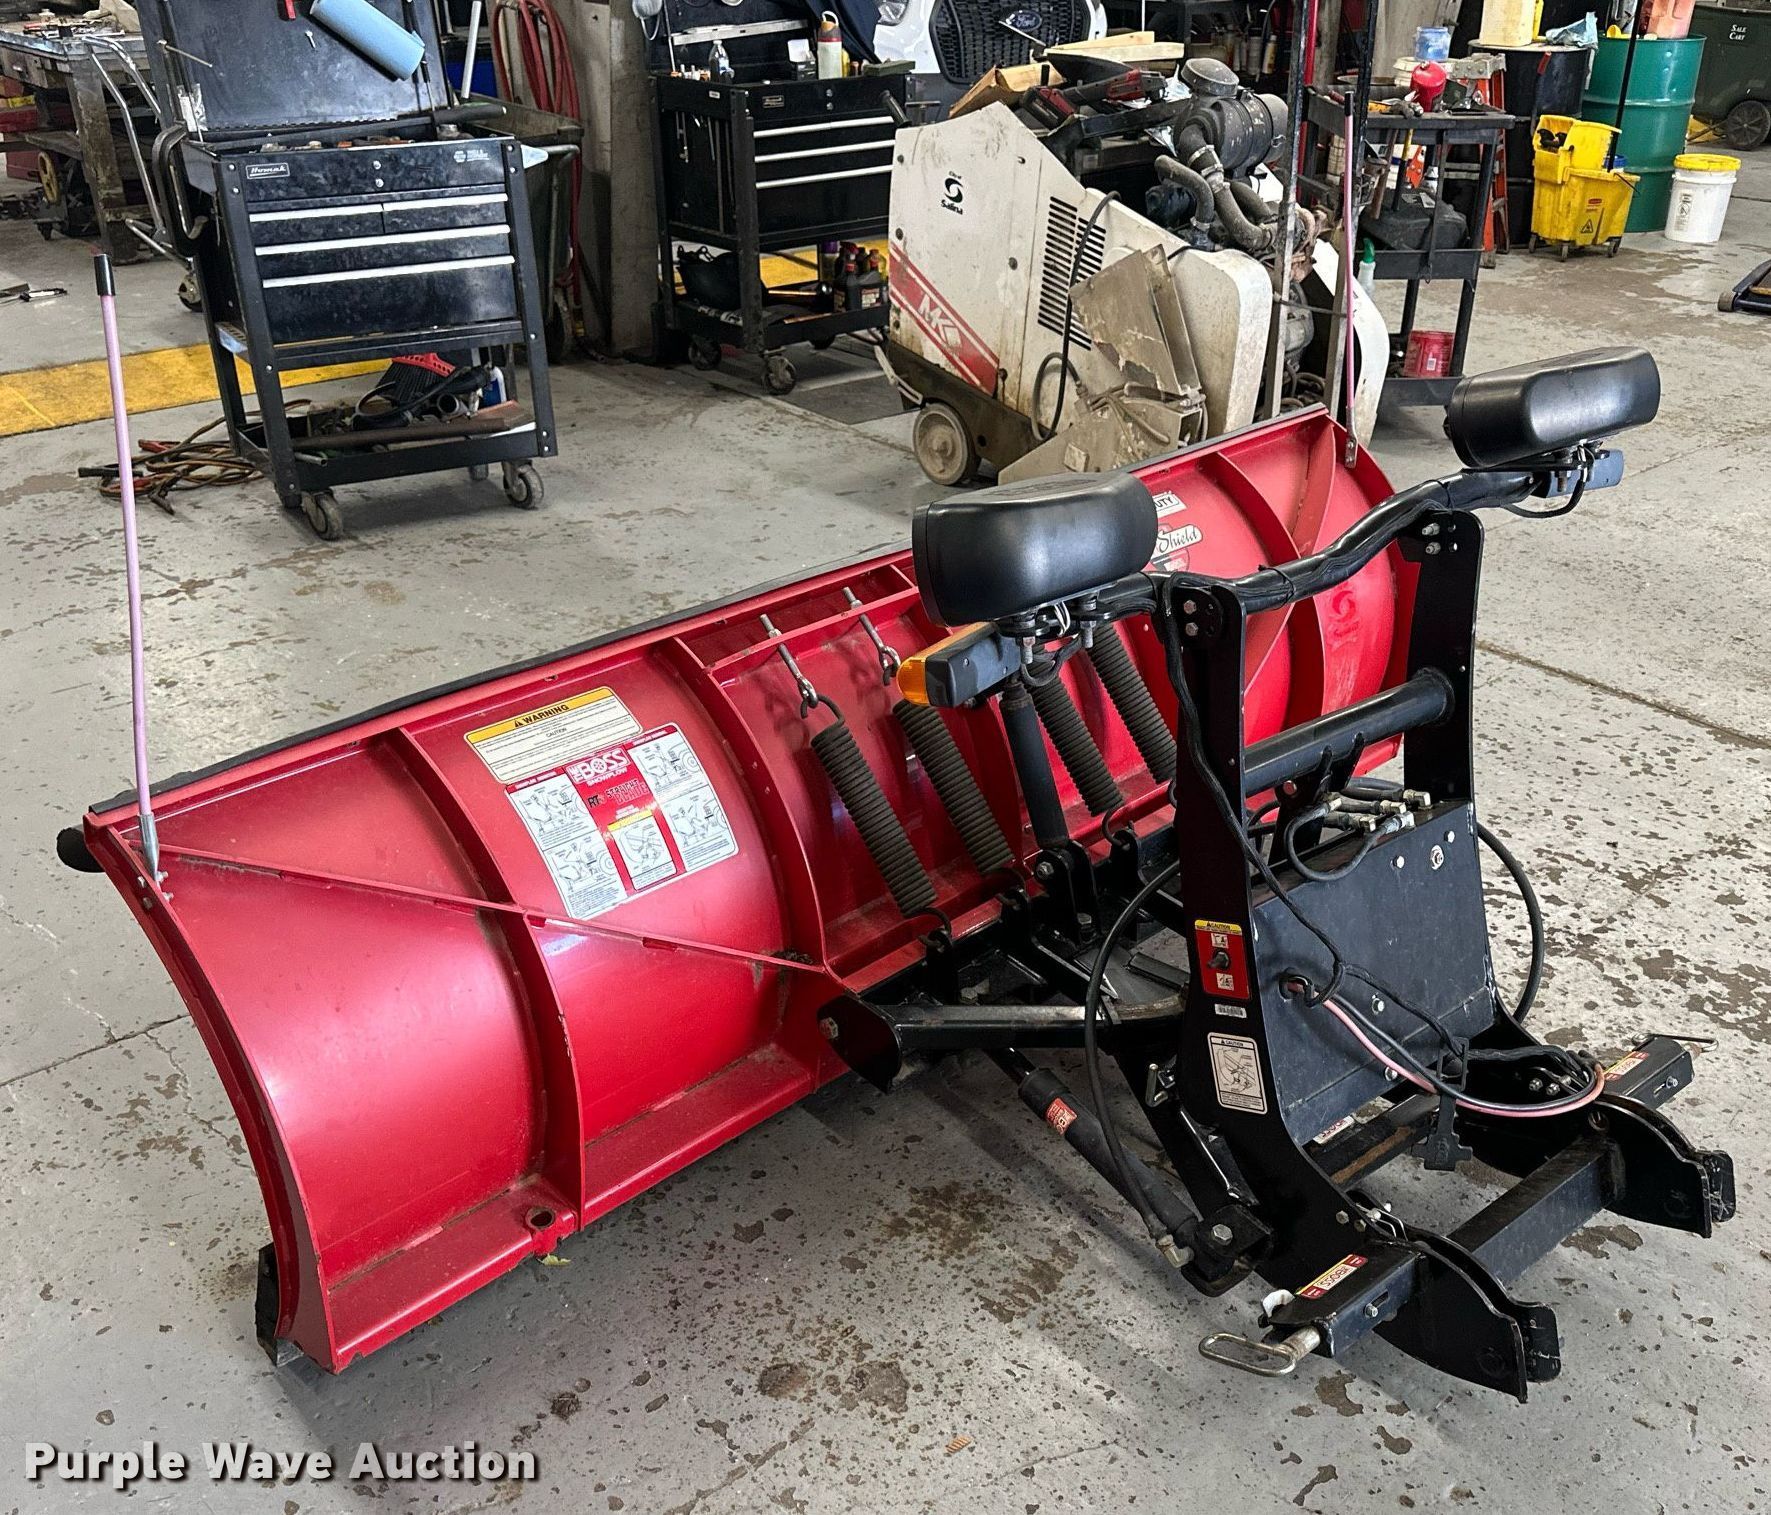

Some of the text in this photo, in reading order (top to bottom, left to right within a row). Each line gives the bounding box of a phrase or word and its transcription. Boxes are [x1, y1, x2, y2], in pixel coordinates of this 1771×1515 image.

[1154, 496, 1174, 508] UTY
[1157, 527, 1198, 553] Shield
[522, 704, 570, 724] WARNING
[546, 727, 567, 738] CAUTION
[579, 749, 628, 781] BOSS
